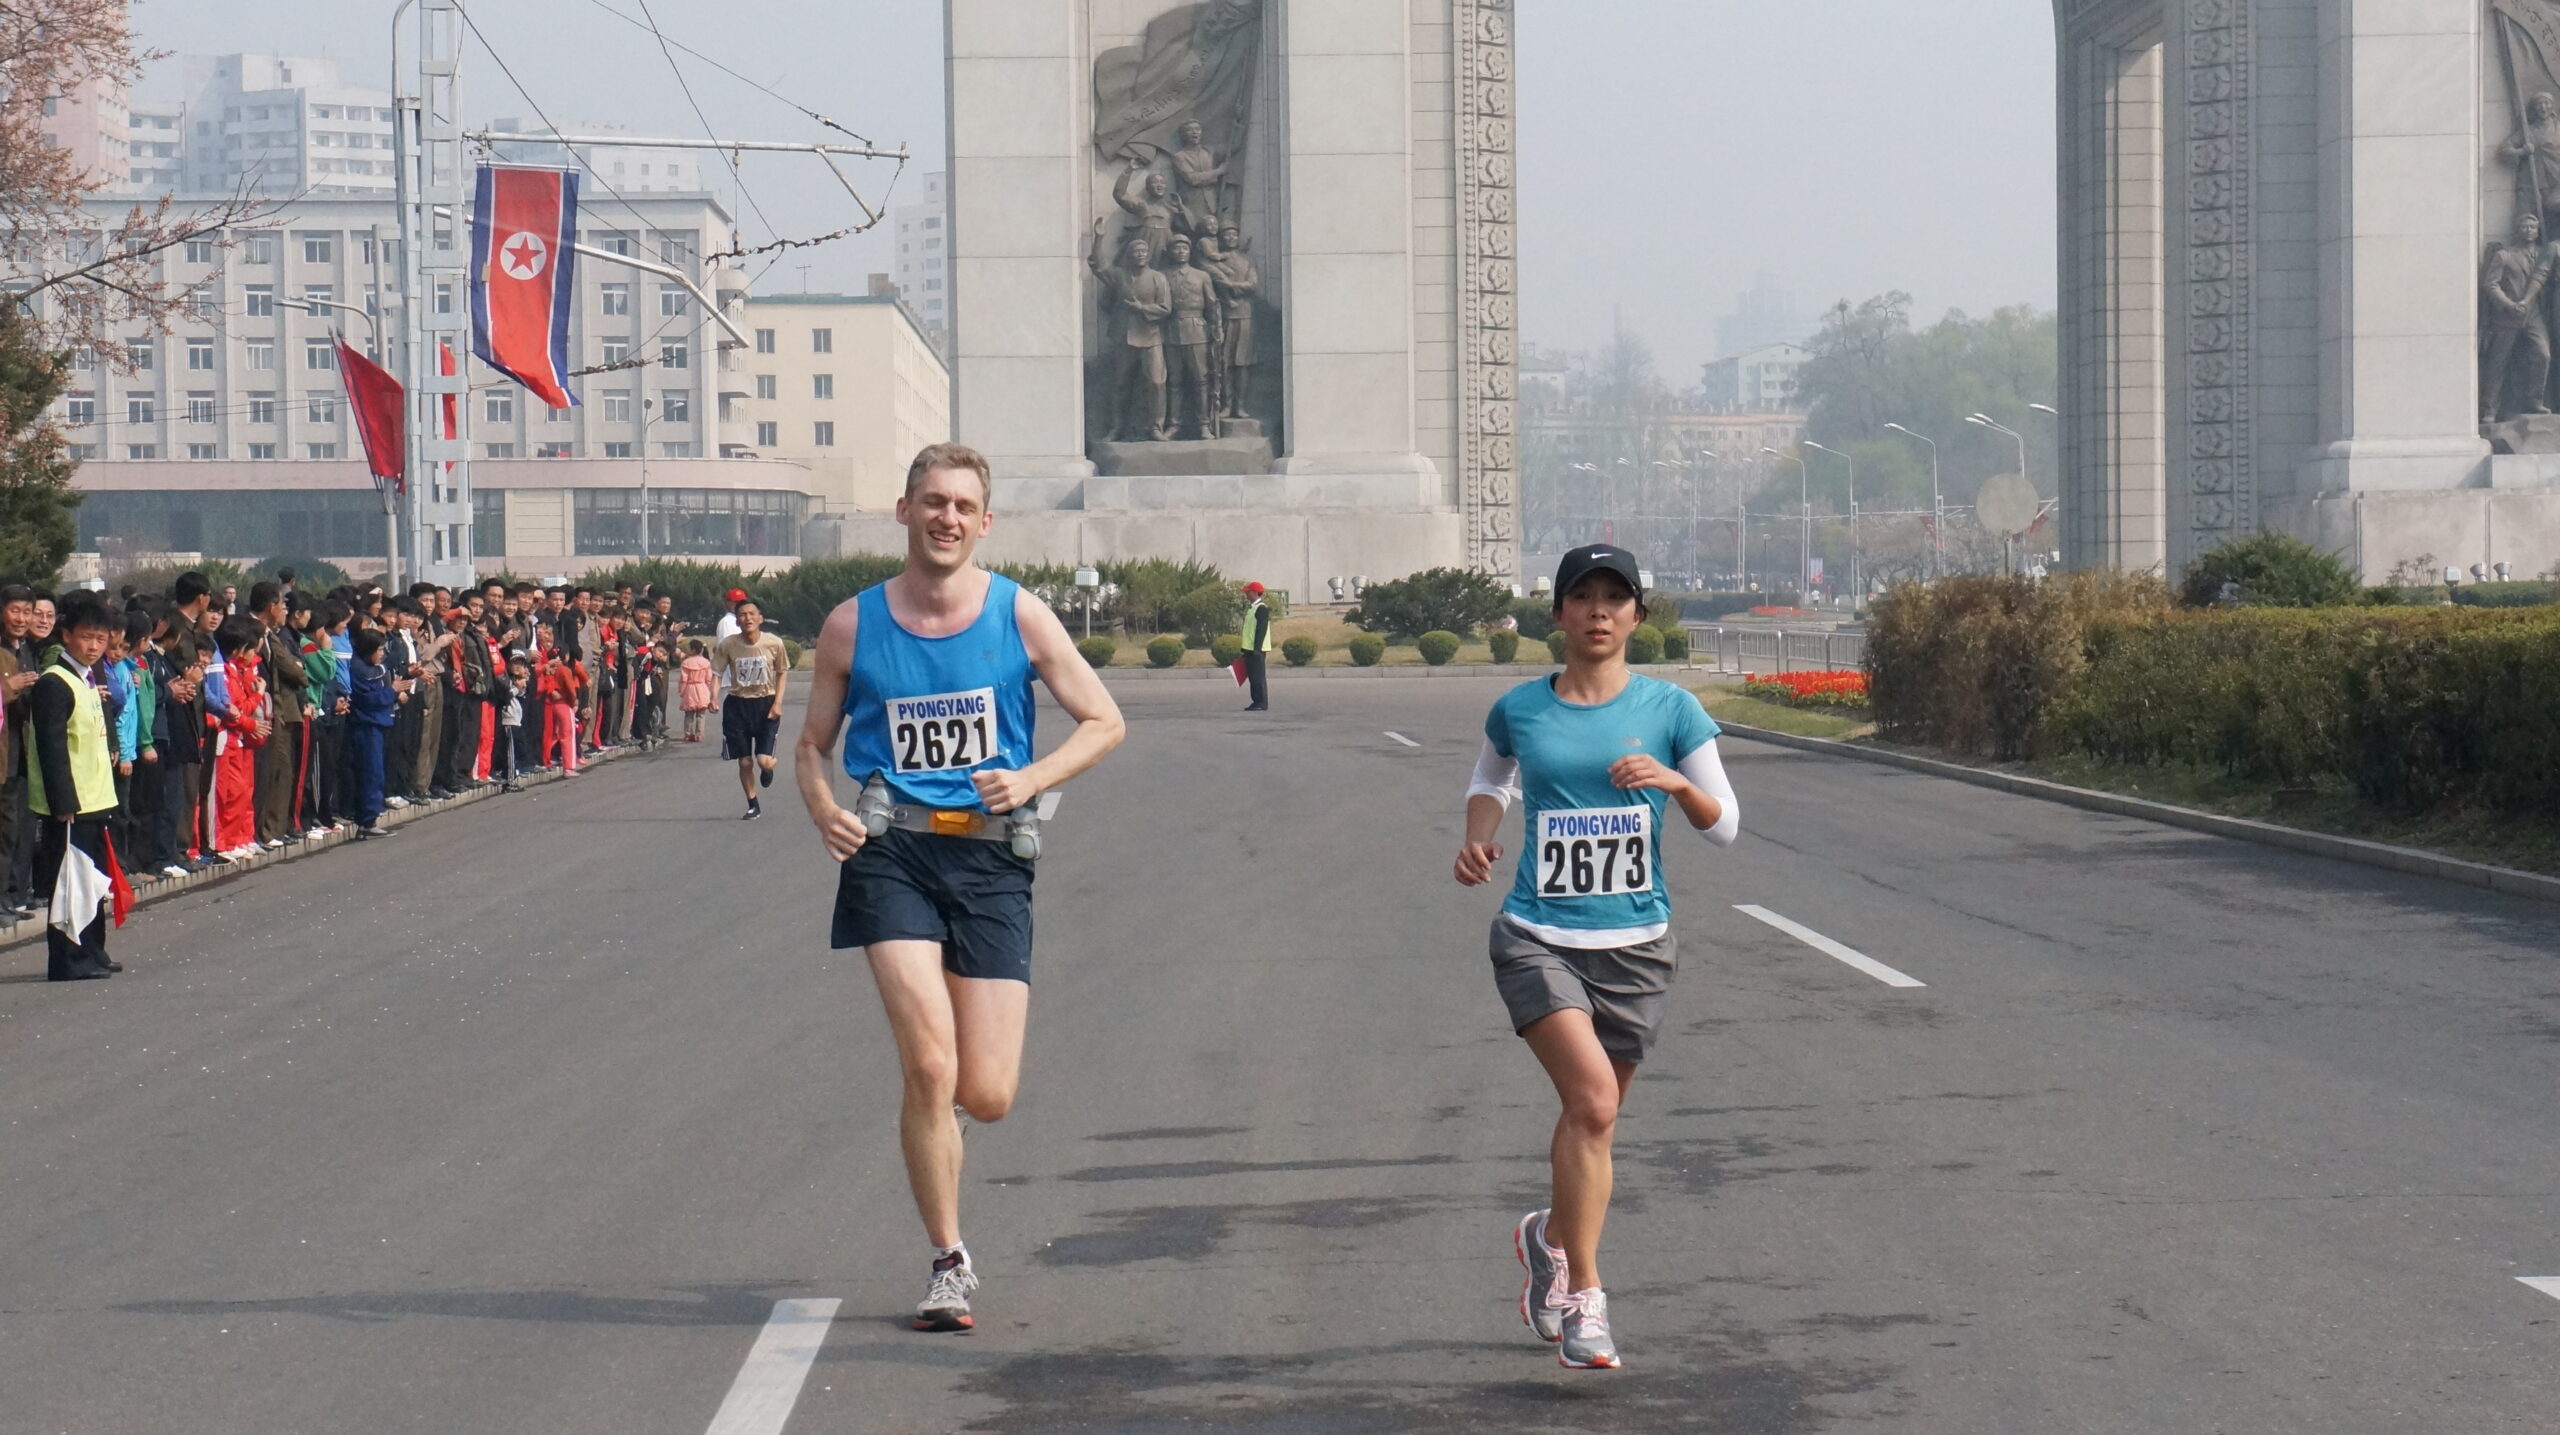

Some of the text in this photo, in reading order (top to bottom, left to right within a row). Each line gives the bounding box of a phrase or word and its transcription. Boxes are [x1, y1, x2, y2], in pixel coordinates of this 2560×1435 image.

[898, 695, 985, 719] PYONGYANG
[897, 717, 987, 770] 2621
[1548, 812, 1642, 837] PYONGYANG
[1543, 836, 1646, 894] 2673
